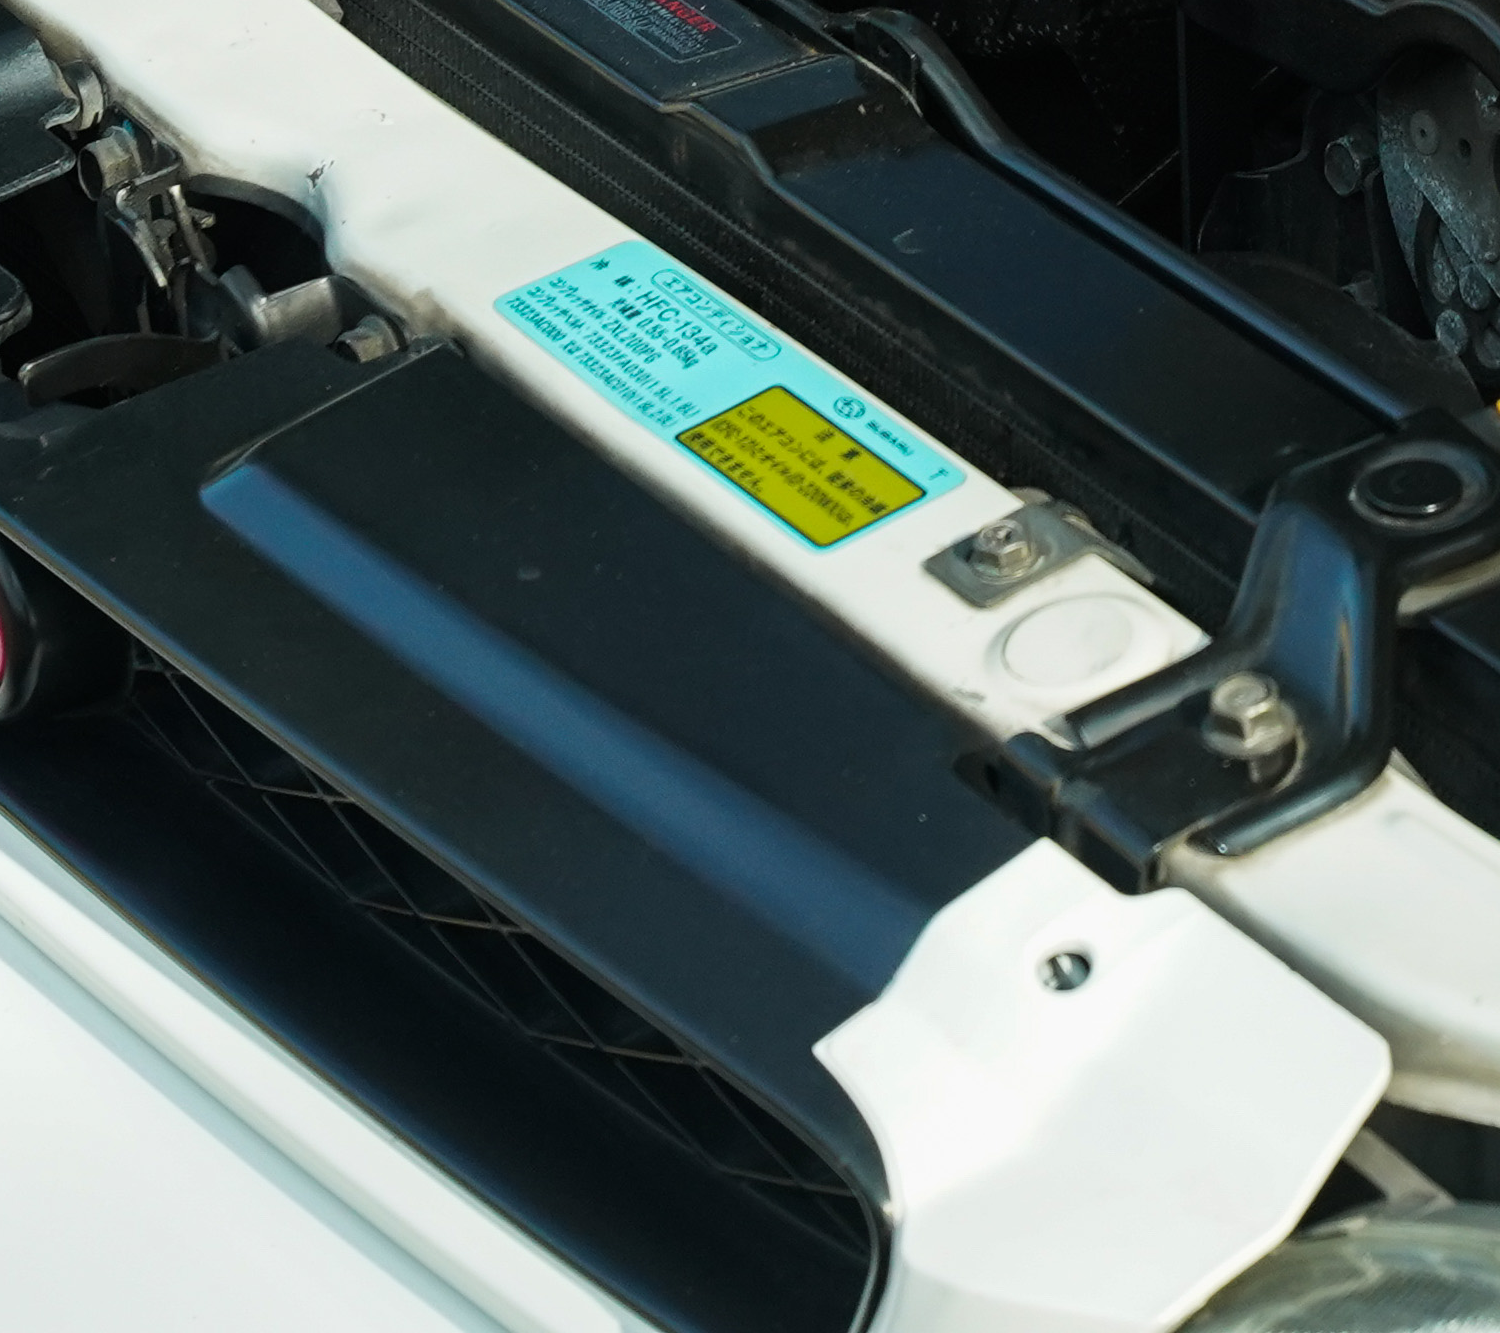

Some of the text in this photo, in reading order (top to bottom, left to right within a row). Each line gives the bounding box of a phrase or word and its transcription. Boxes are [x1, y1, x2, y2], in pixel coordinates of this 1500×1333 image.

[637, 289, 719, 355] HFC-134a
[658, 274, 776, 354] エアコンディショナ
[862, 419, 919, 457] SUBARU
